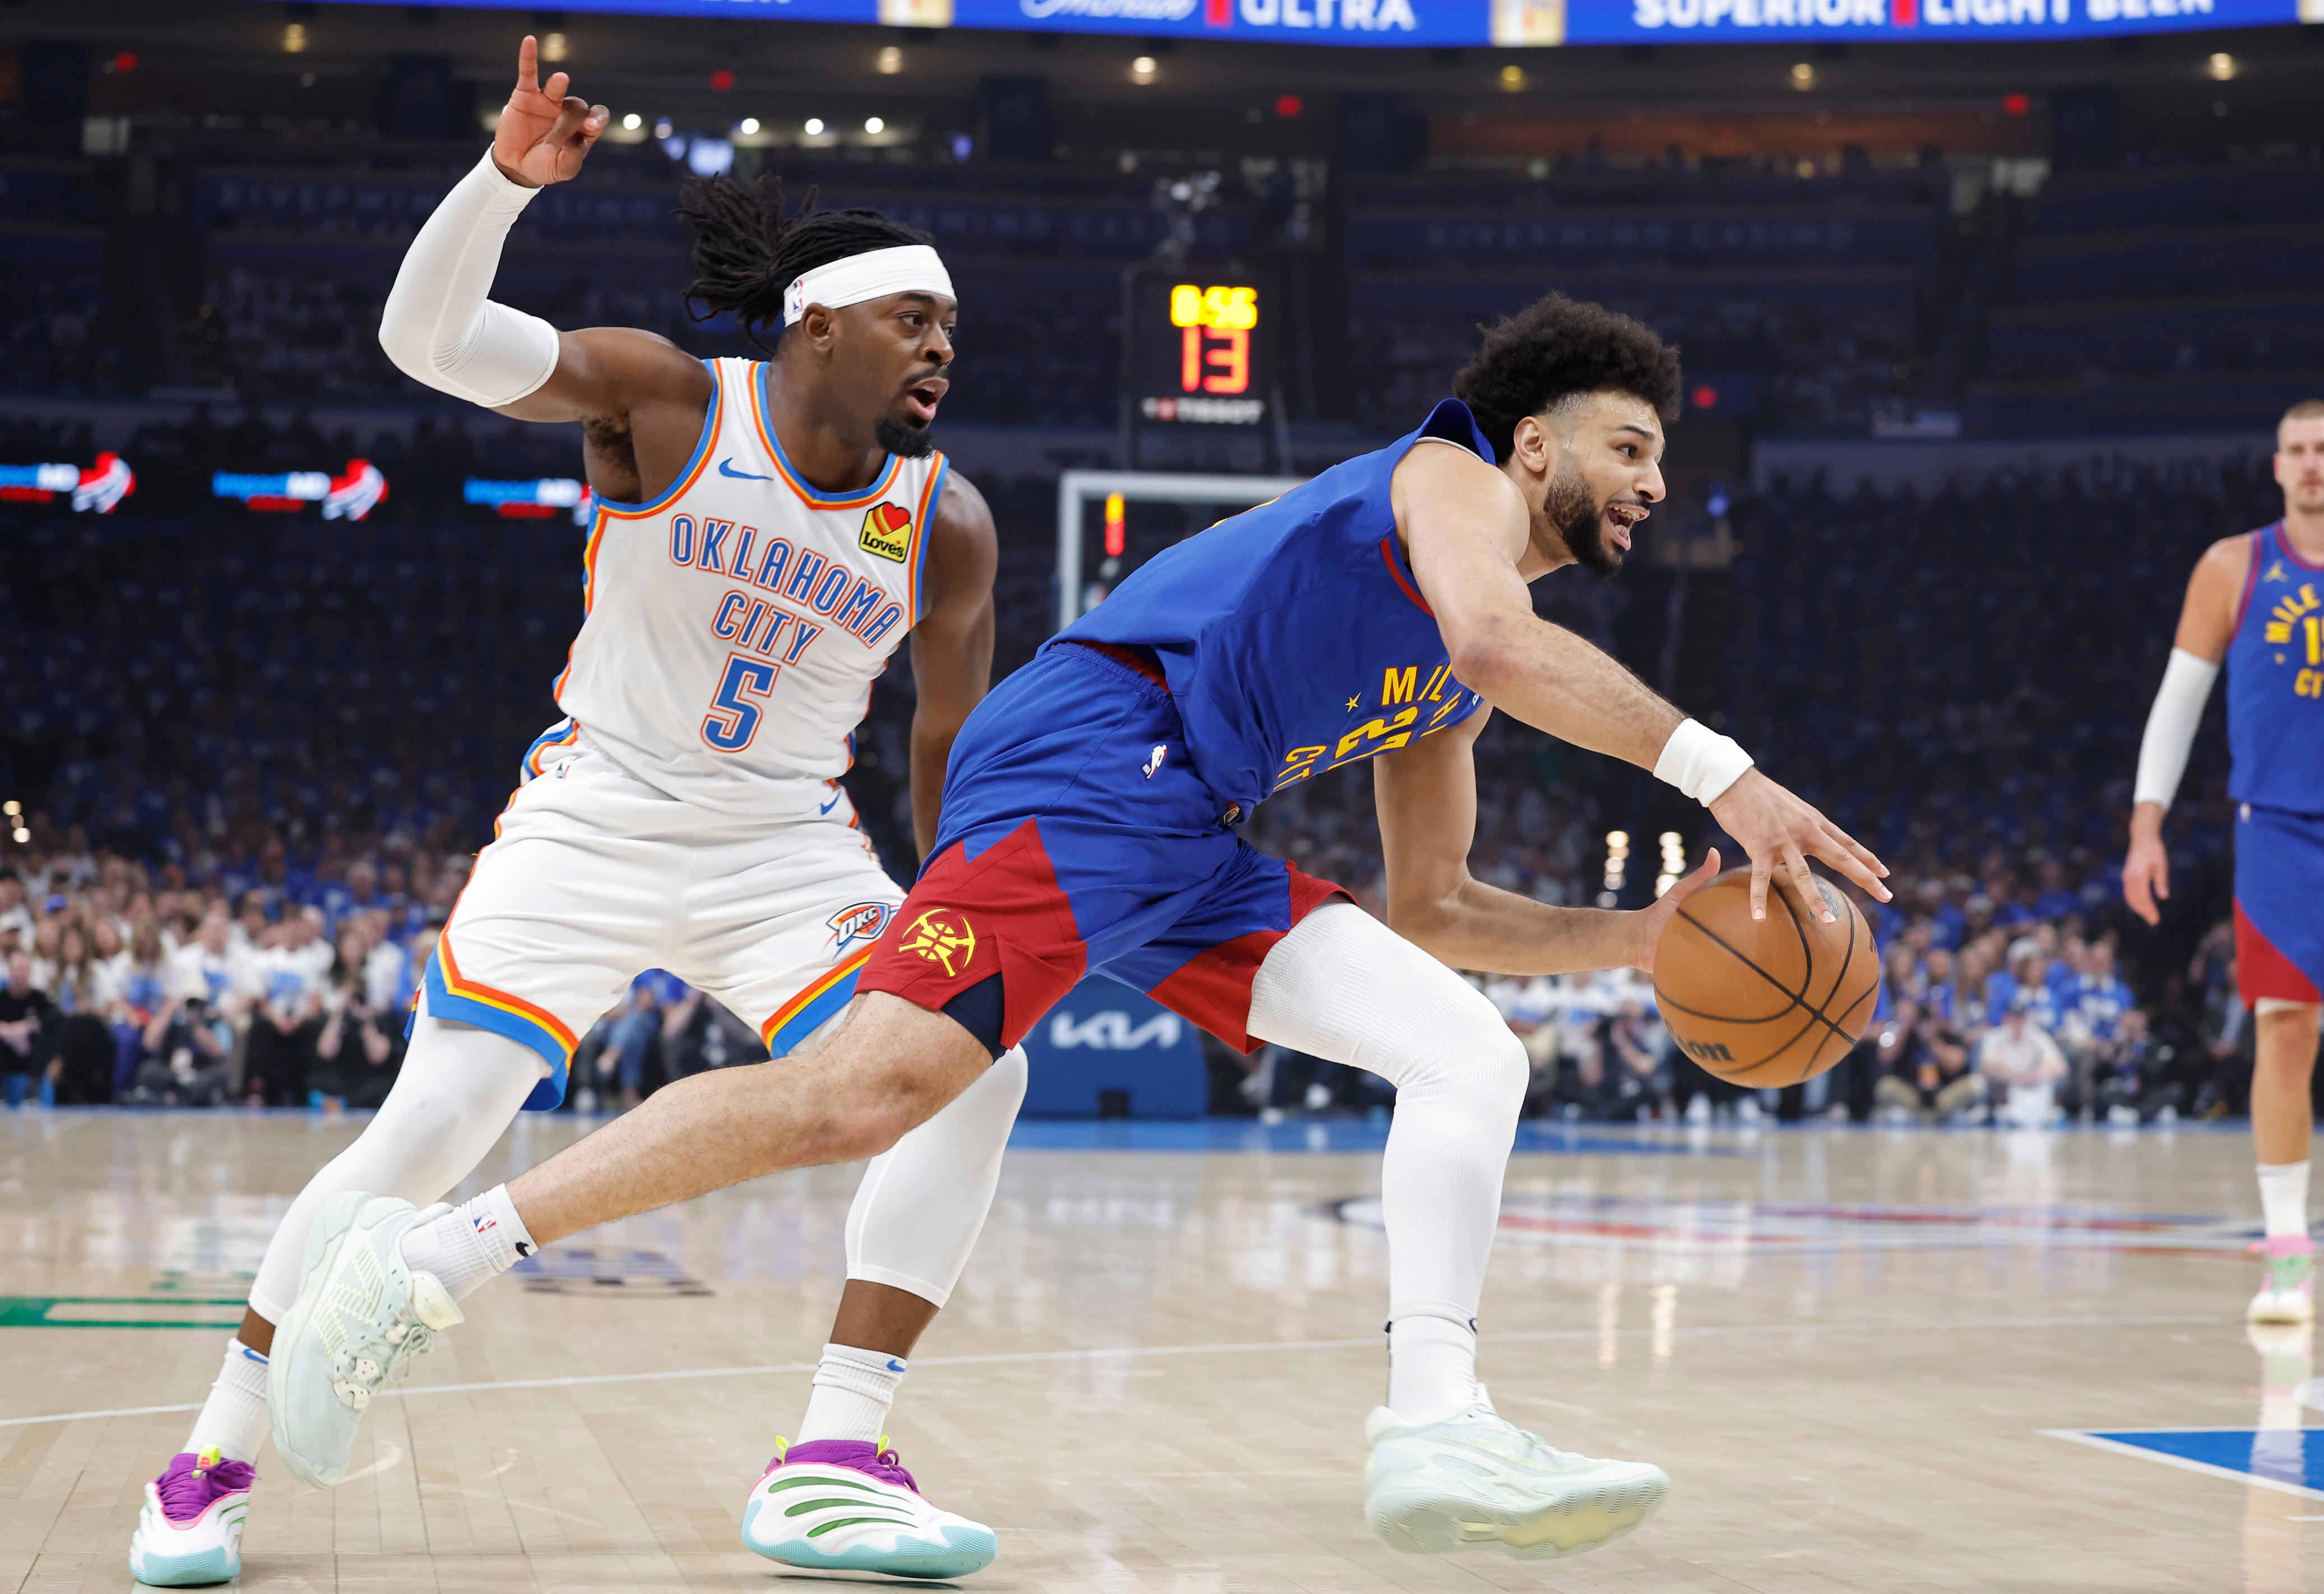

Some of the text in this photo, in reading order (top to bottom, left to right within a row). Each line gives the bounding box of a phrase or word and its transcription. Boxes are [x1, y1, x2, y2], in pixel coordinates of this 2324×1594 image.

[1182, 325, 1250, 393] 13
[670, 513, 904, 648] OKLAHOMA
[711, 590, 824, 666] CITY
[2302, 617, 2324, 666] 1
[701, 651, 781, 753] 5
[1381, 665, 1453, 706] MIL
